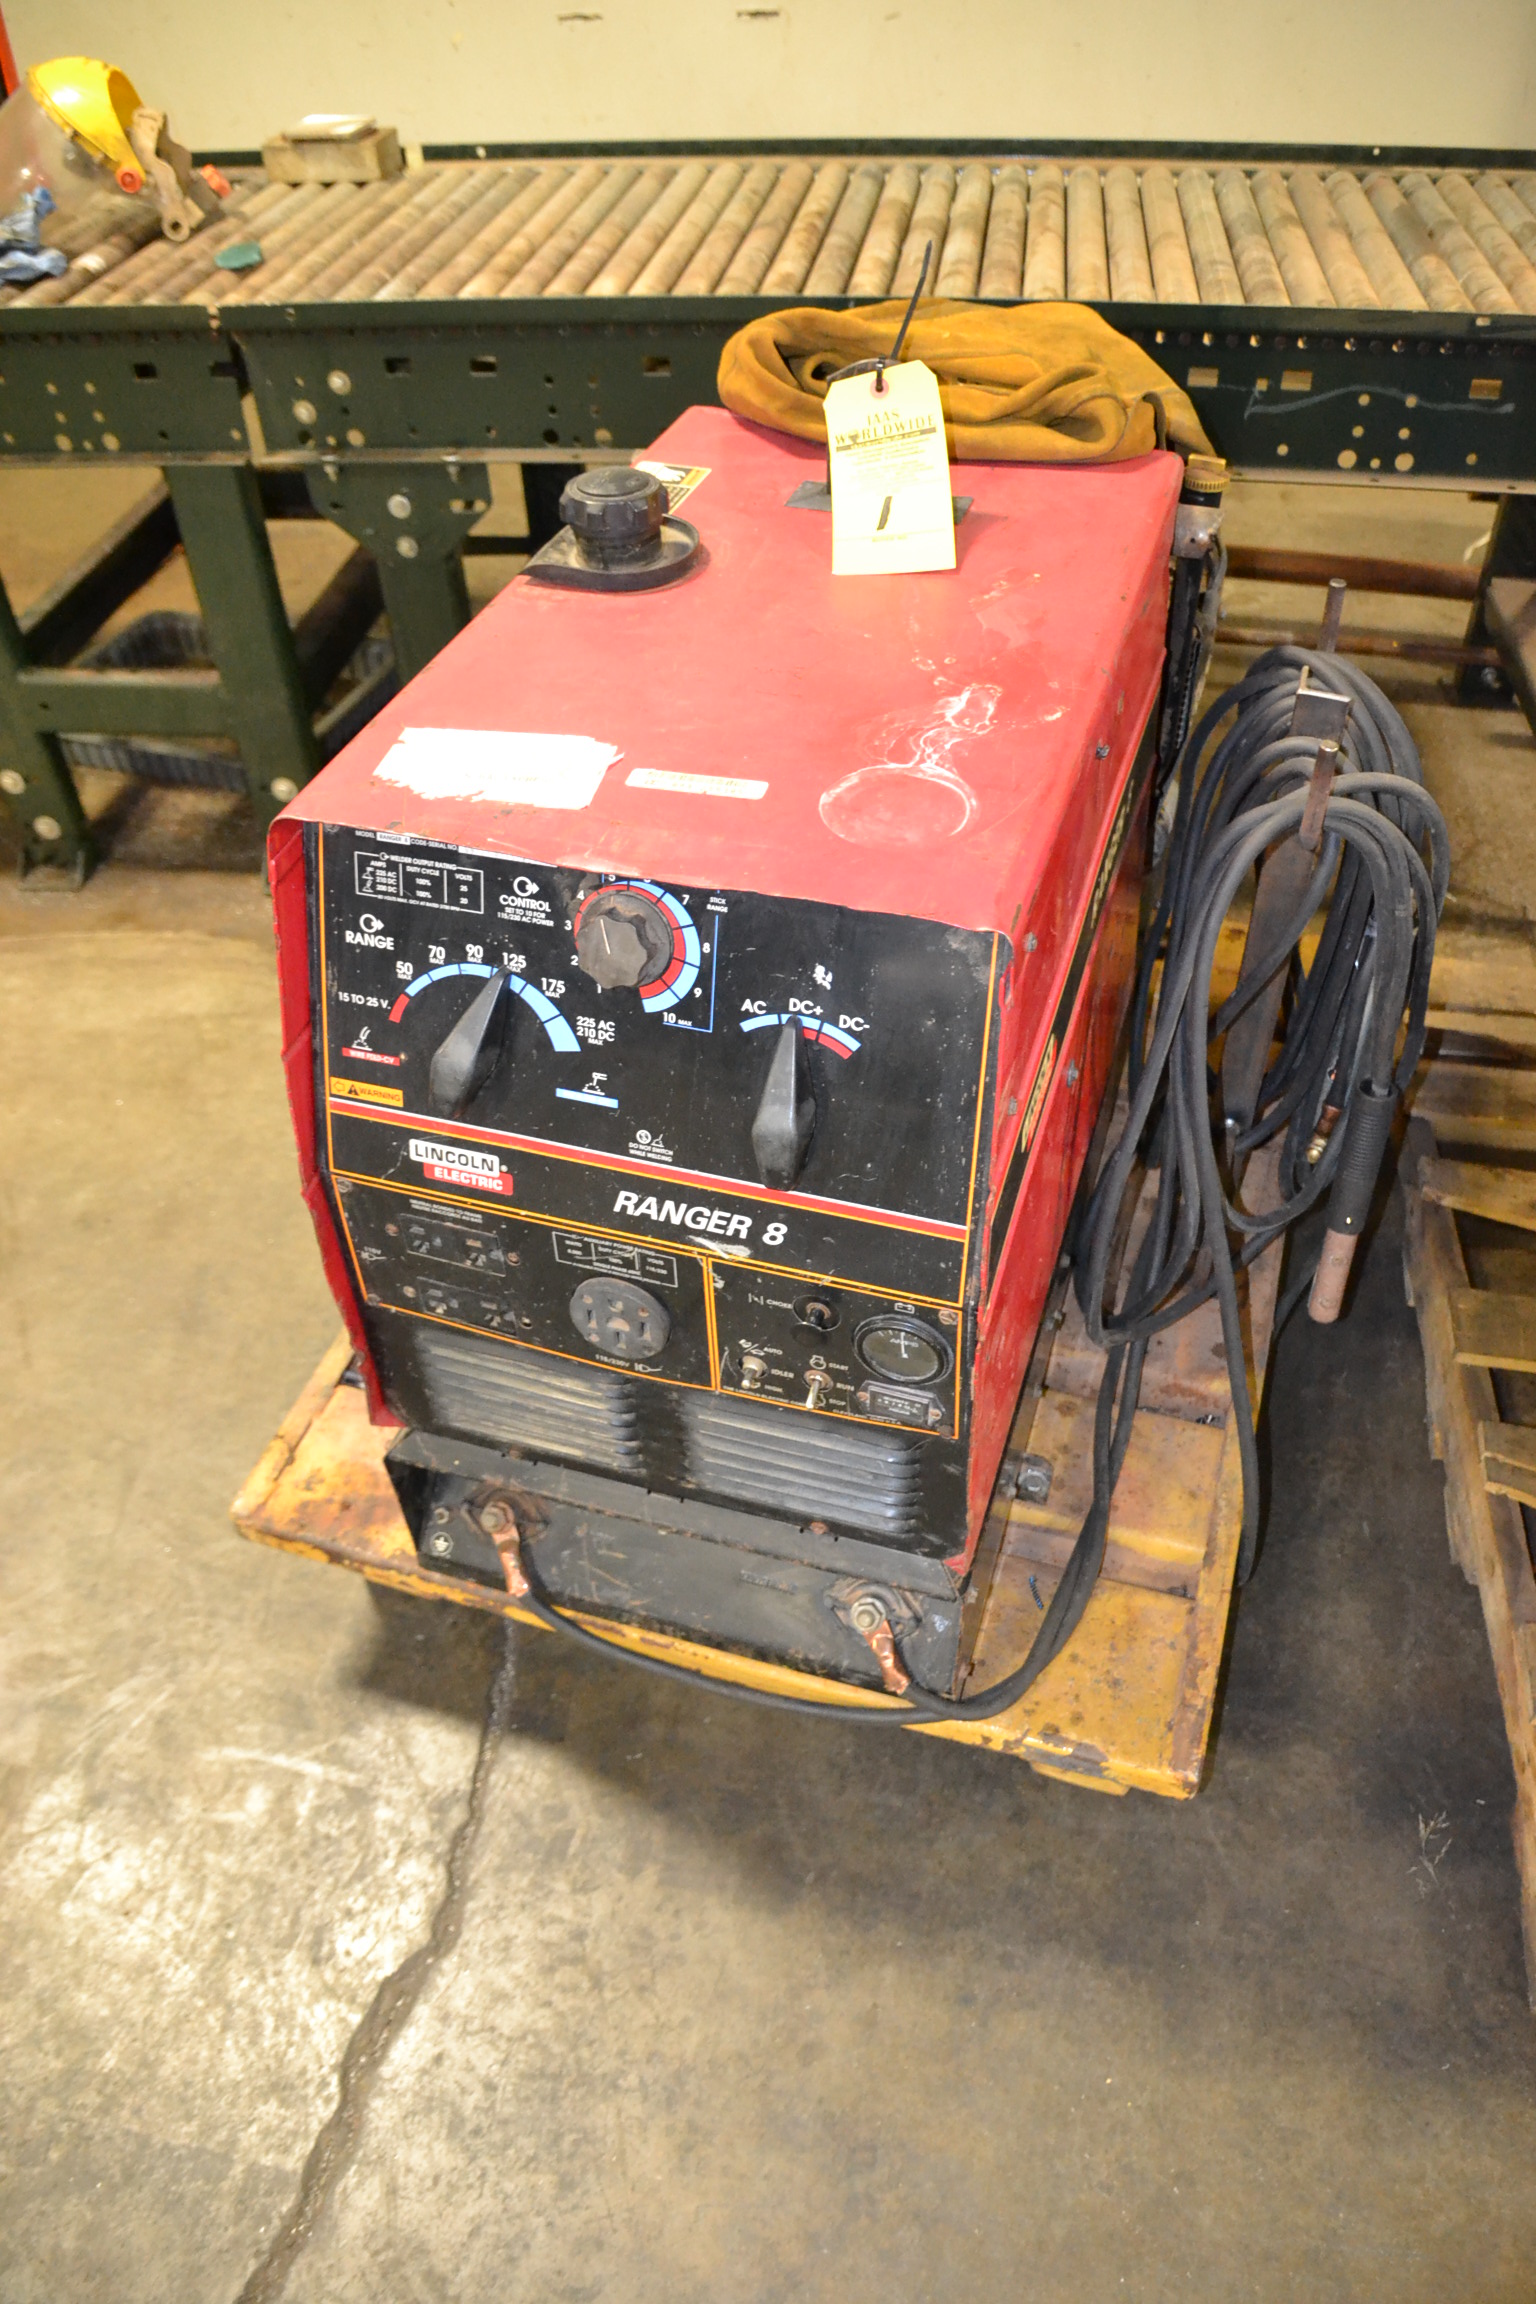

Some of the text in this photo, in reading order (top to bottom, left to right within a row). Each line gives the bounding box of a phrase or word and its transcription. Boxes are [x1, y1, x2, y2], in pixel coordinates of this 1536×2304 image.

[355, 830, 375, 839] MODEL
[370, 860, 387, 868] AMPS
[413, 858, 434, 867] OUTPUT
[435, 861, 457, 870] RATING
[421, 868, 440, 876] CYCLE
[577, 890, 585, 900] 4
[682, 894, 690, 905] 7
[709, 896, 726, 905] STICK
[499, 894, 551, 912] CONTROL
[706, 904, 728, 913] RANGE
[533, 911, 546, 919] FOR
[521, 915, 531, 923] AC
[532, 918, 554, 927] POWER
[564, 920, 572, 931] 3
[345, 930, 394, 950] RANGE
[428, 945, 446, 960] 70
[465, 944, 483, 958] 90
[703, 943, 711, 954] 8
[429, 957, 444, 965] MAX
[467, 956, 482, 964] MAX
[502, 952, 527, 969] 125
[571, 955, 579, 966] 2
[396, 961, 413, 975] 50
[397, 973, 412, 981] MAX
[541, 977, 566, 994] 175
[597, 984, 602, 994] 1
[545, 990, 560, 998] MAX
[694, 988, 702, 998] 9
[338, 991, 349, 1002] 15
[351, 994, 364, 1004] TO
[366, 997, 379, 1008] 25
[740, 998, 767, 1015] AC
[788, 997, 823, 1015] DC+
[663, 1012, 676, 1023] 10
[839, 1014, 870, 1031] DC-
[576, 1016, 616, 1032] 225 AC
[576, 1026, 615, 1042] 210 DC
[588, 1037, 604, 1046] MAX
[360, 1087, 401, 1102] WARNING
[628, 1141, 639, 1149] DO
[415, 1143, 494, 1172] LINCOLN
[433, 1166, 503, 1191] ELECTRIC
[613, 1190, 788, 1246] RANGER 8
[763, 1346, 783, 1355] AUTO
[828, 1362, 849, 1371] START
[770, 1368, 795, 1379] IDLER
[764, 1384, 783, 1393] HIGH
[836, 1382, 855, 1392] RUN
[829, 1398, 846, 1406] STOP
